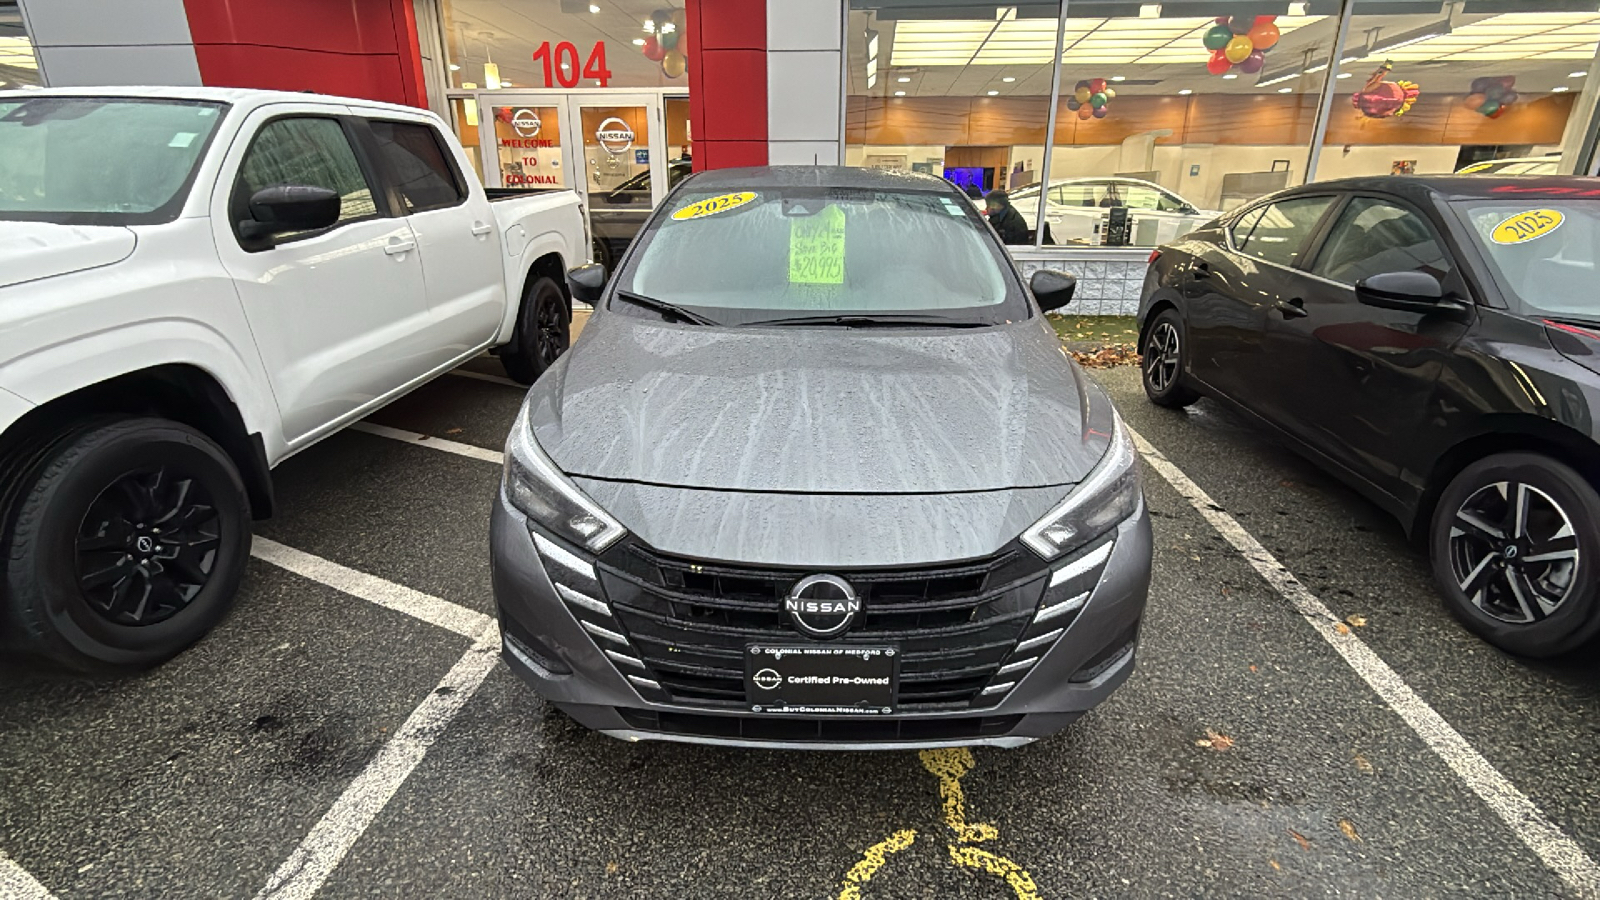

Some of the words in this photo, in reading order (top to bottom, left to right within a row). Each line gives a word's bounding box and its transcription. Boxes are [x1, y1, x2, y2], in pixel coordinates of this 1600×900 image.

[533, 41, 612, 88] 104
[502, 139, 553, 148] WELCOME
[522, 157, 537, 166] TO
[506, 175, 558, 184] COLONIAL
[691, 193, 743, 216] 2025
[1505, 211, 1554, 239] 2025
[786, 599, 860, 612] NISSAN
[788, 676, 830, 684] Certified
[833, 676, 889, 685] Pre-Owned
